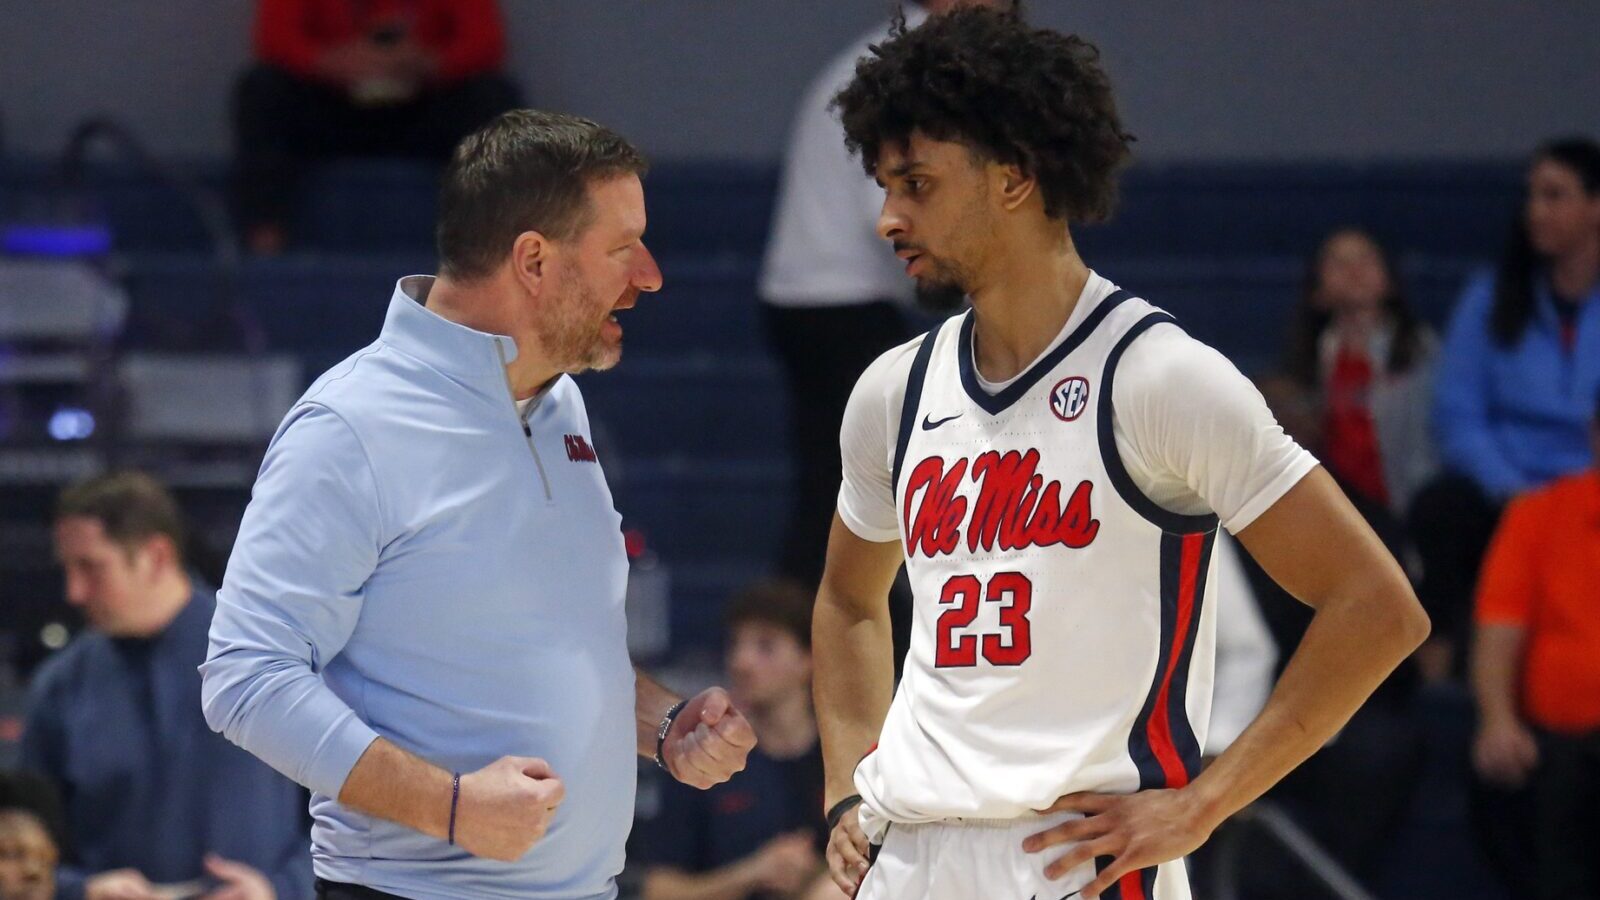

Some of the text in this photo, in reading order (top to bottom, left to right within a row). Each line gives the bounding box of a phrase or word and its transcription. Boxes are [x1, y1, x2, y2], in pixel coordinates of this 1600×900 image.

[1053, 379, 1088, 418] SEC
[904, 448, 1100, 558] Ole Miss
[935, 571, 1032, 668] 23
